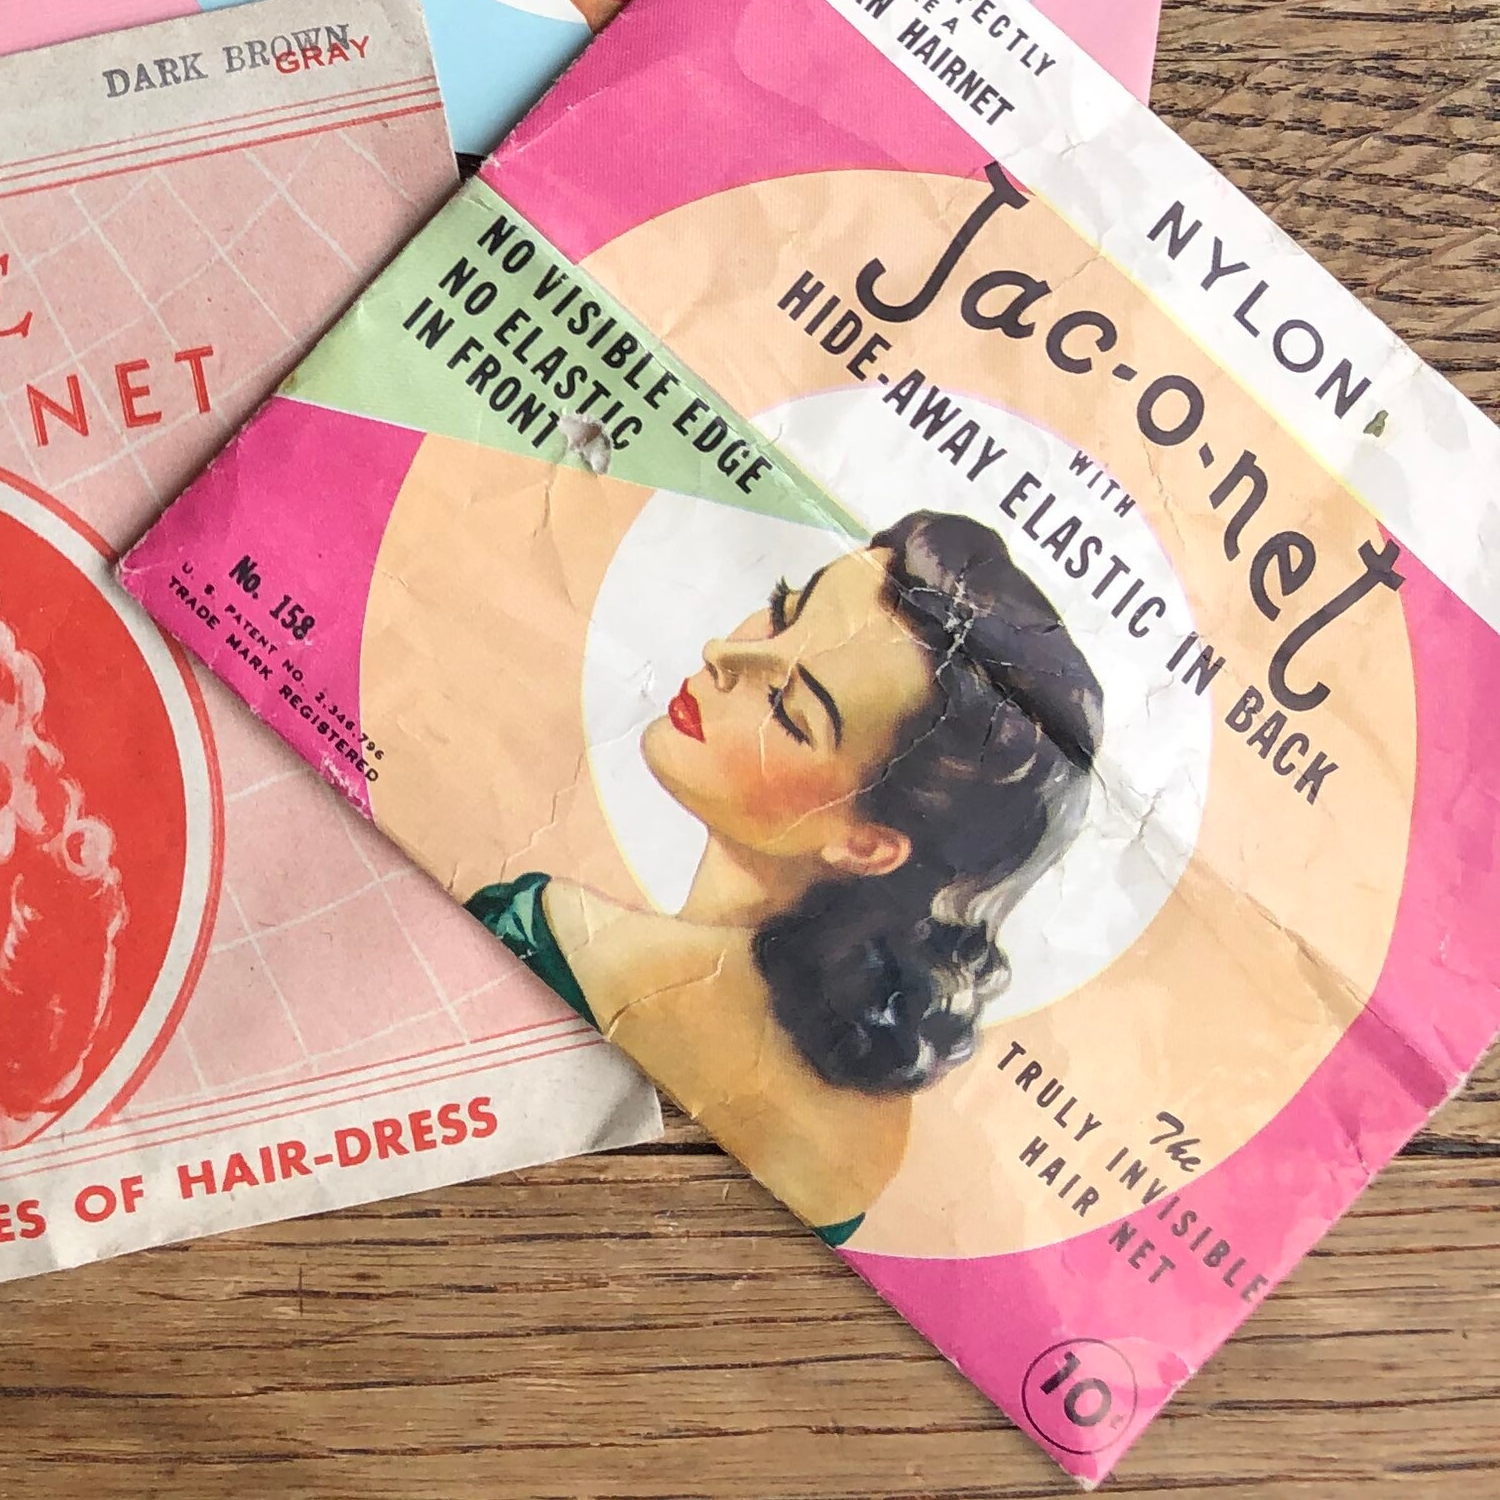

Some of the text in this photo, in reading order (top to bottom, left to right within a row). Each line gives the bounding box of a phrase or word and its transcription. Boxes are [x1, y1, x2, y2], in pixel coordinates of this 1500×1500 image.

[102, 23, 351, 99] DARK BROWN
[275, 35, 370, 74] GRAY
[898, 12, 1016, 128] HAIRNET
[941, 15, 959, 36] A
[401, 297, 563, 452] IN FRONT
[439, 257, 645, 453] NO ELASTIC
[476, 214, 772, 496] NO VISIBLE EDGE
[1147, 200, 1372, 419] NYLON
[26, 345, 215, 448] NET
[856, 161, 1406, 713] Jac-o-net
[778, 270, 1339, 806] HIDE-AWAY ELASTIC IN BACK
[1069, 448, 1136, 519] WITH
[225, 604, 278, 655] PATENT
[228, 555, 315, 640] No. 158
[169, 575, 379, 782] TRADE MARK REGISTERED
[75, 1176, 147, 1225] OF
[178, 1095, 502, 1201] HAIR-DRESS
[997, 1040, 1270, 1304] TRULY INVISIBLE
[1147, 1110, 1202, 1173] The
[1018, 1135, 1178, 1286] HAIR NET
